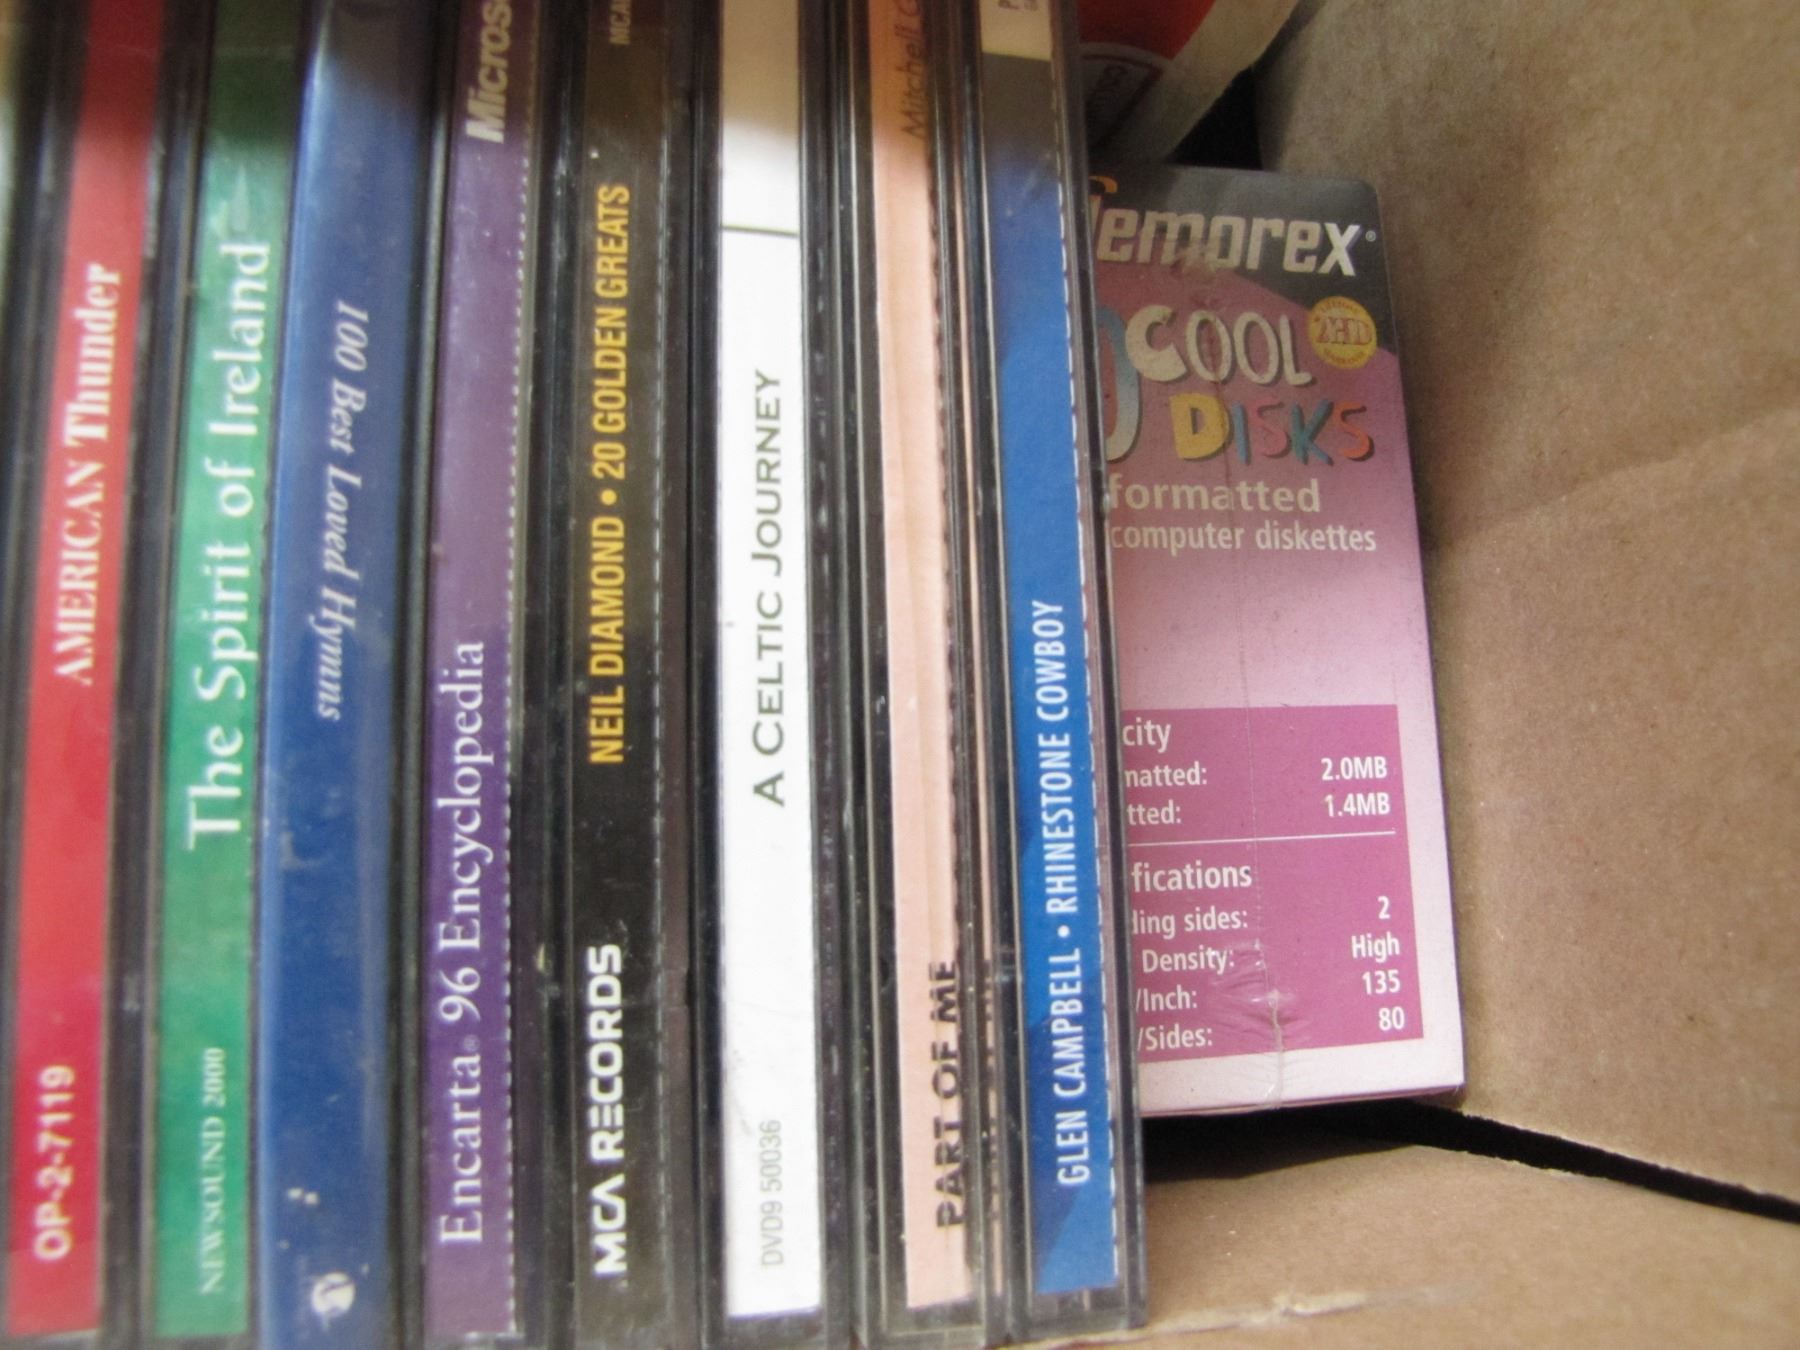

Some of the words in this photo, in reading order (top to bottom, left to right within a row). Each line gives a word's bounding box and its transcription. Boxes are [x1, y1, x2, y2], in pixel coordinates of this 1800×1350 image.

[595, 185, 630, 298] GREATS
[1092, 206, 1359, 276] emorex
[64, 263, 121, 442] Thunder
[209, 240, 271, 437] Ireland
[335, 300, 370, 372] 100
[592, 306, 628, 432] GOLDEN
[1126, 305, 1313, 386] COOL
[329, 378, 367, 455] Best
[1170, 392, 1373, 465] DISKS
[204, 460, 255, 517] of
[591, 442, 625, 480] 20
[751, 369, 782, 577] JOURNEY
[1109, 473, 1321, 512] formatted
[324, 464, 362, 580] Loved
[1111, 522, 1245, 556] computer
[1256, 520, 1377, 551] diskettes
[54, 461, 104, 687] AMERICAN
[590, 514, 625, 676] DIAMOND
[196, 541, 258, 700] Spirit
[308, 585, 357, 721] Hymns
[753, 593, 784, 757] CELTIC
[1032, 600, 1069, 723] COWBOY
[589, 682, 625, 764] NEIL
[187, 726, 243, 851] The
[437, 641, 493, 951] Encyclopedia
[753, 771, 785, 808] A
[1321, 756, 1387, 781] 2.0MB
[1324, 792, 1391, 818] 1.4MB
[1038, 732, 1078, 915] RHINESTONE
[1185, 909, 1248, 933] sides:
[1352, 932, 1400, 962] High
[1378, 897, 1390, 920] 2
[438, 965, 482, 1023] 96
[928, 960, 957, 1023] ME
[1135, 985, 1197, 1013] /Inch:
[1142, 946, 1234, 975] Density:
[1362, 971, 1400, 995] 135
[587, 942, 623, 1165] RECORDS
[1049, 948, 1087, 1100] CAMPBELL
[1137, 1025, 1213, 1052] /Sides:
[1379, 1007, 1405, 1031] 80
[201, 1047, 226, 1108] 2000
[930, 1042, 960, 1100] OF
[34, 1065, 74, 1262] OP-2-7119
[438, 1052, 484, 1246] Encarta
[759, 1117, 782, 1192] 50036
[933, 1117, 965, 1228] PART
[1056, 1109, 1091, 1187] GLEN
[595, 1172, 628, 1278] MCA
[760, 1199, 784, 1268] DVD9
